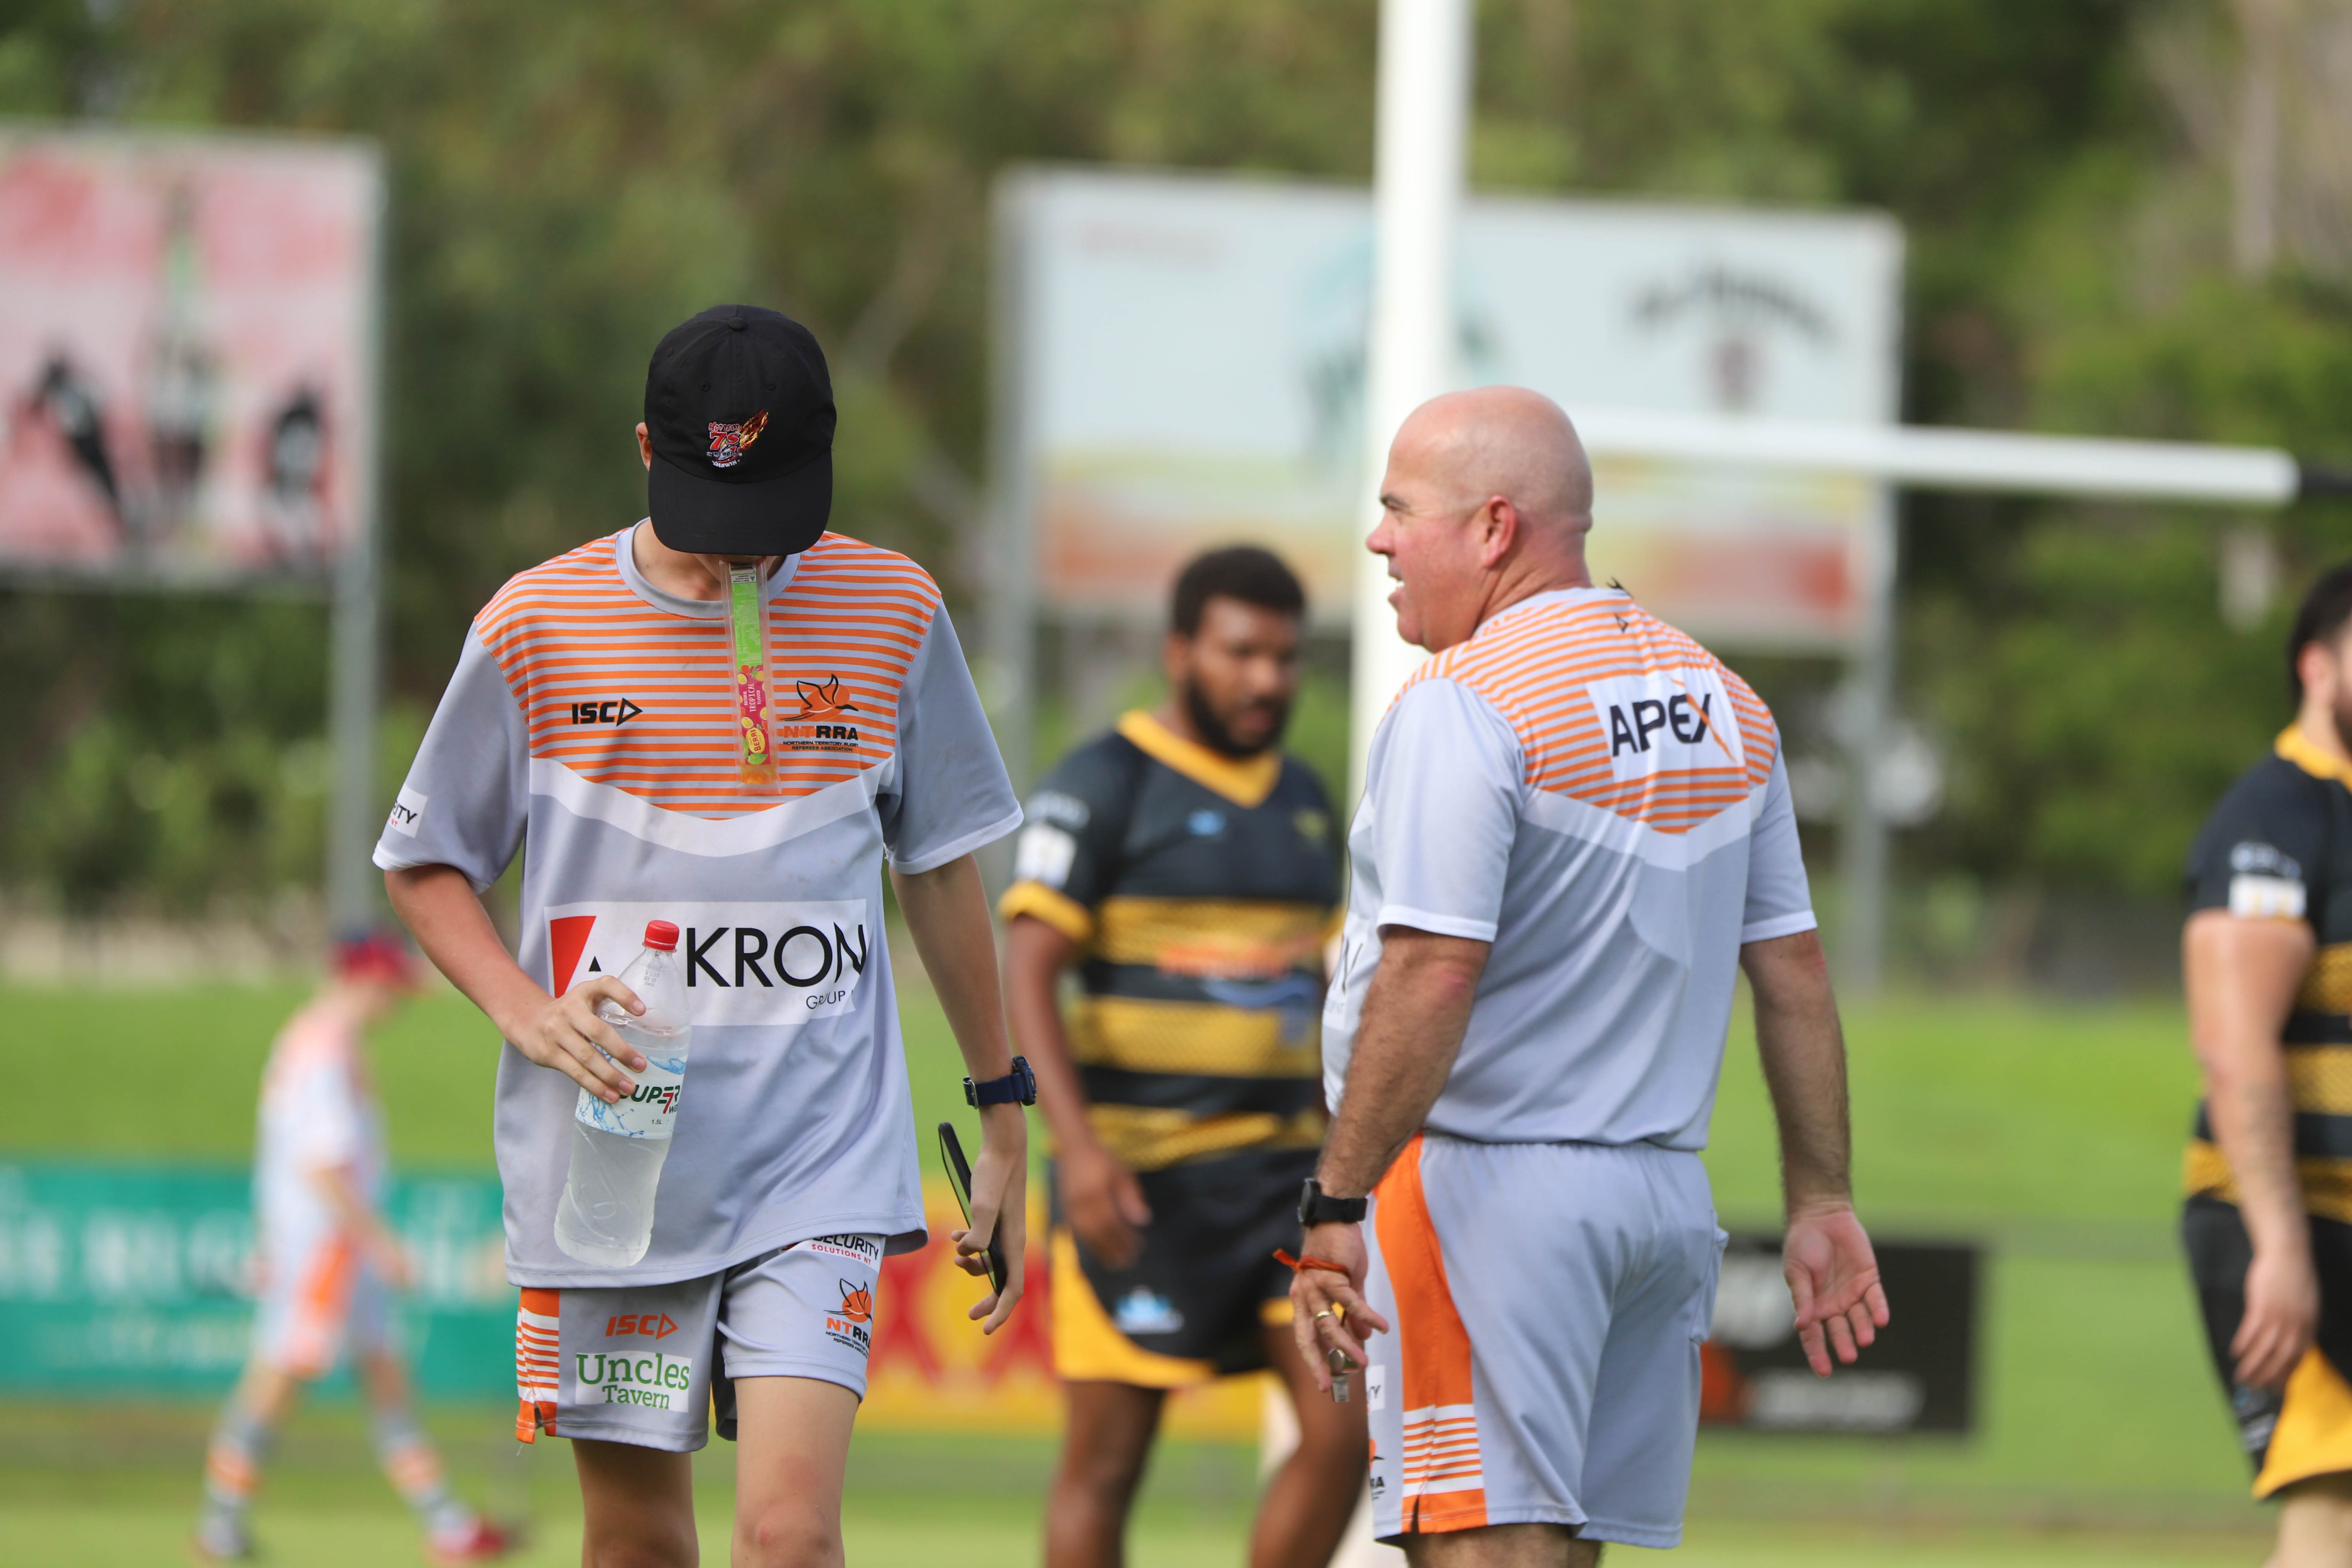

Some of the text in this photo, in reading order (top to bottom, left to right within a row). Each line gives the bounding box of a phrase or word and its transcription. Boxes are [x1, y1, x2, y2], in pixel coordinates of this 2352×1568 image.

[748, 683, 756, 713] TROPICAL
[750, 729, 761, 751] BERRI
[784, 726, 859, 741] NTRRA
[1610, 693, 1737, 763] APEX
[812, 1244, 871, 1265] SOLUTIONS NT
[827, 1317, 870, 1348] NTRR
[576, 1353, 690, 1390] Uncles
[602, 1385, 670, 1410] Tavern
